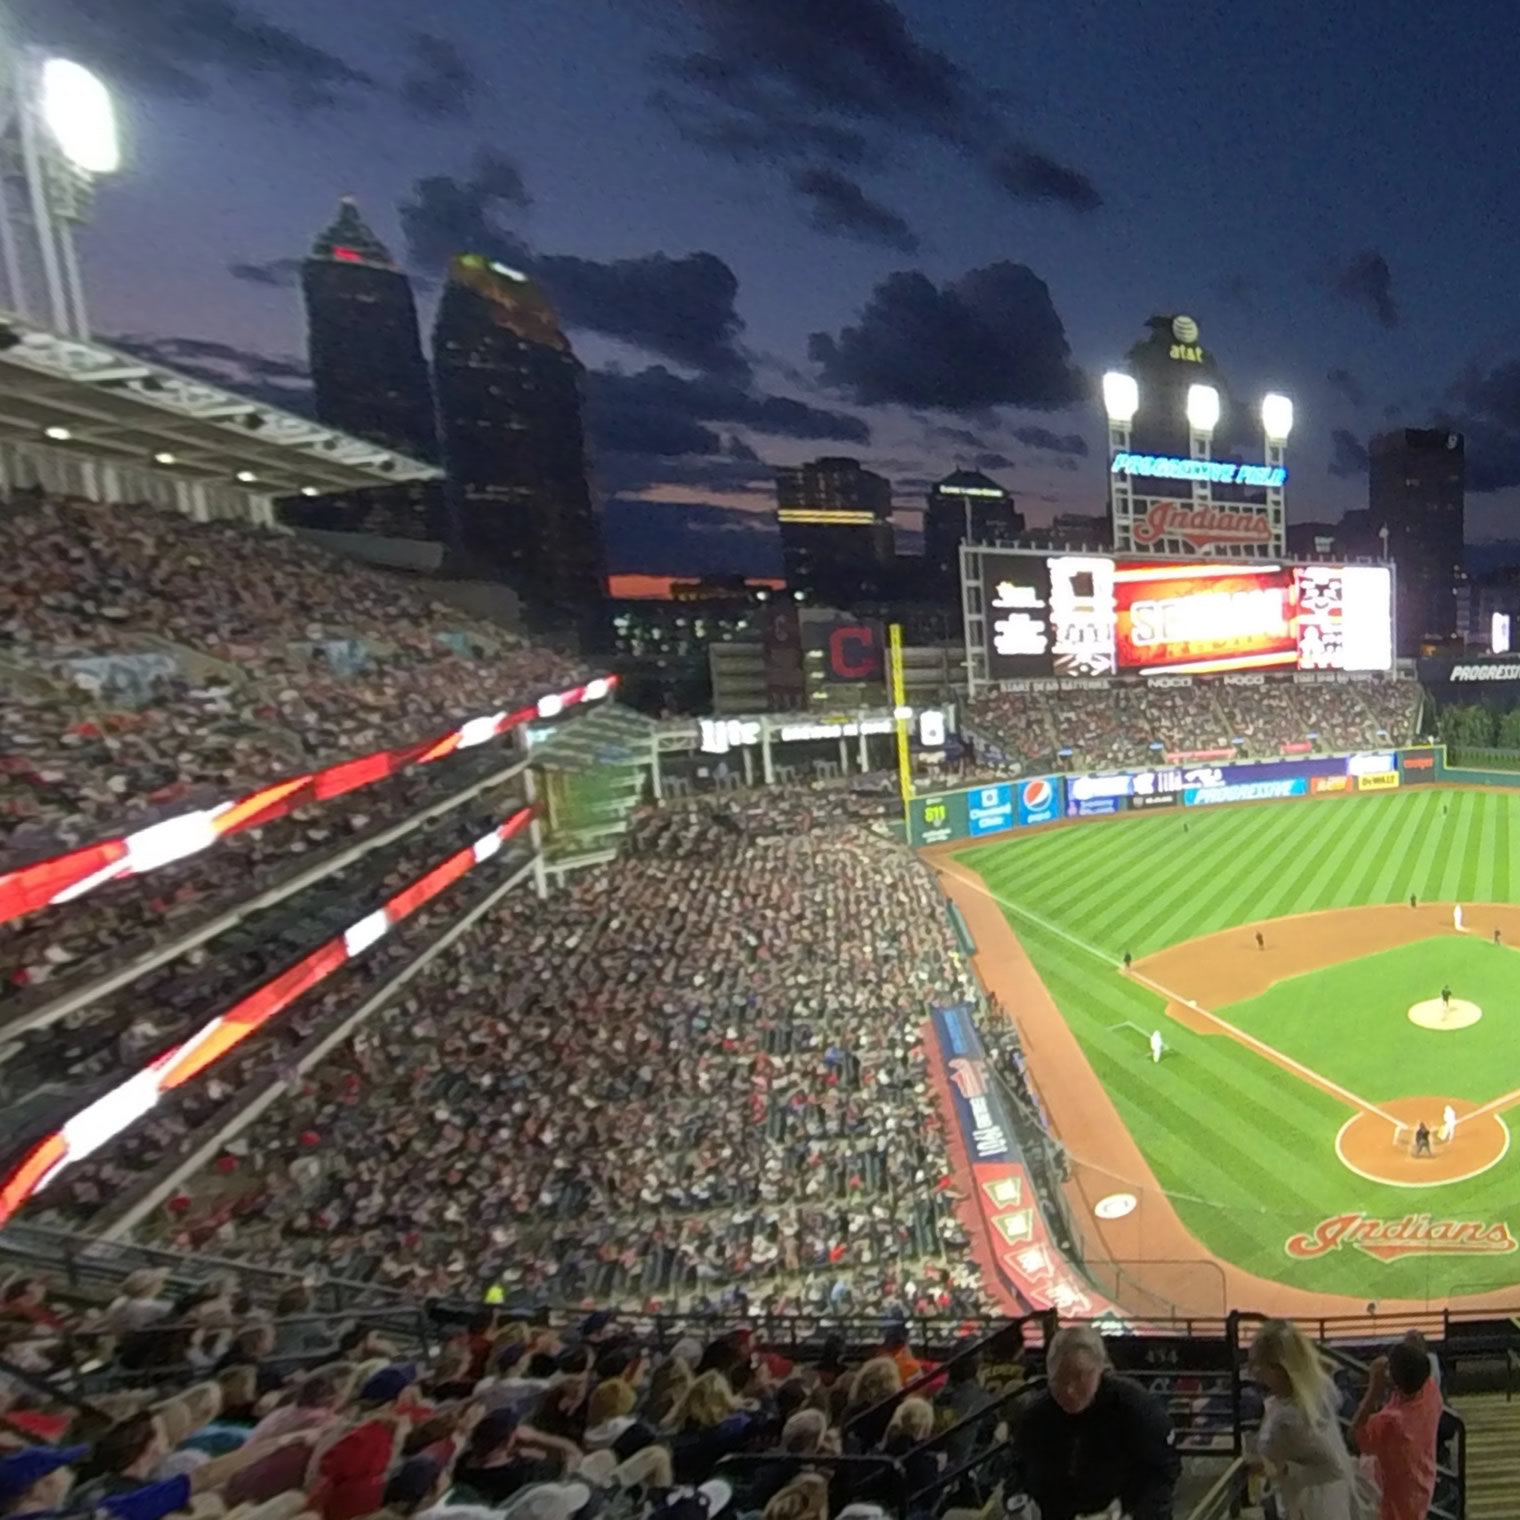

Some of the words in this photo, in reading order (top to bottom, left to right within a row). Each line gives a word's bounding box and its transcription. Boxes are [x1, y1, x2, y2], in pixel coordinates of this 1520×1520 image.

[1132, 499, 1273, 551] Indians
[829, 625, 875, 678] C
[1285, 1212, 1519, 1264] Indians
